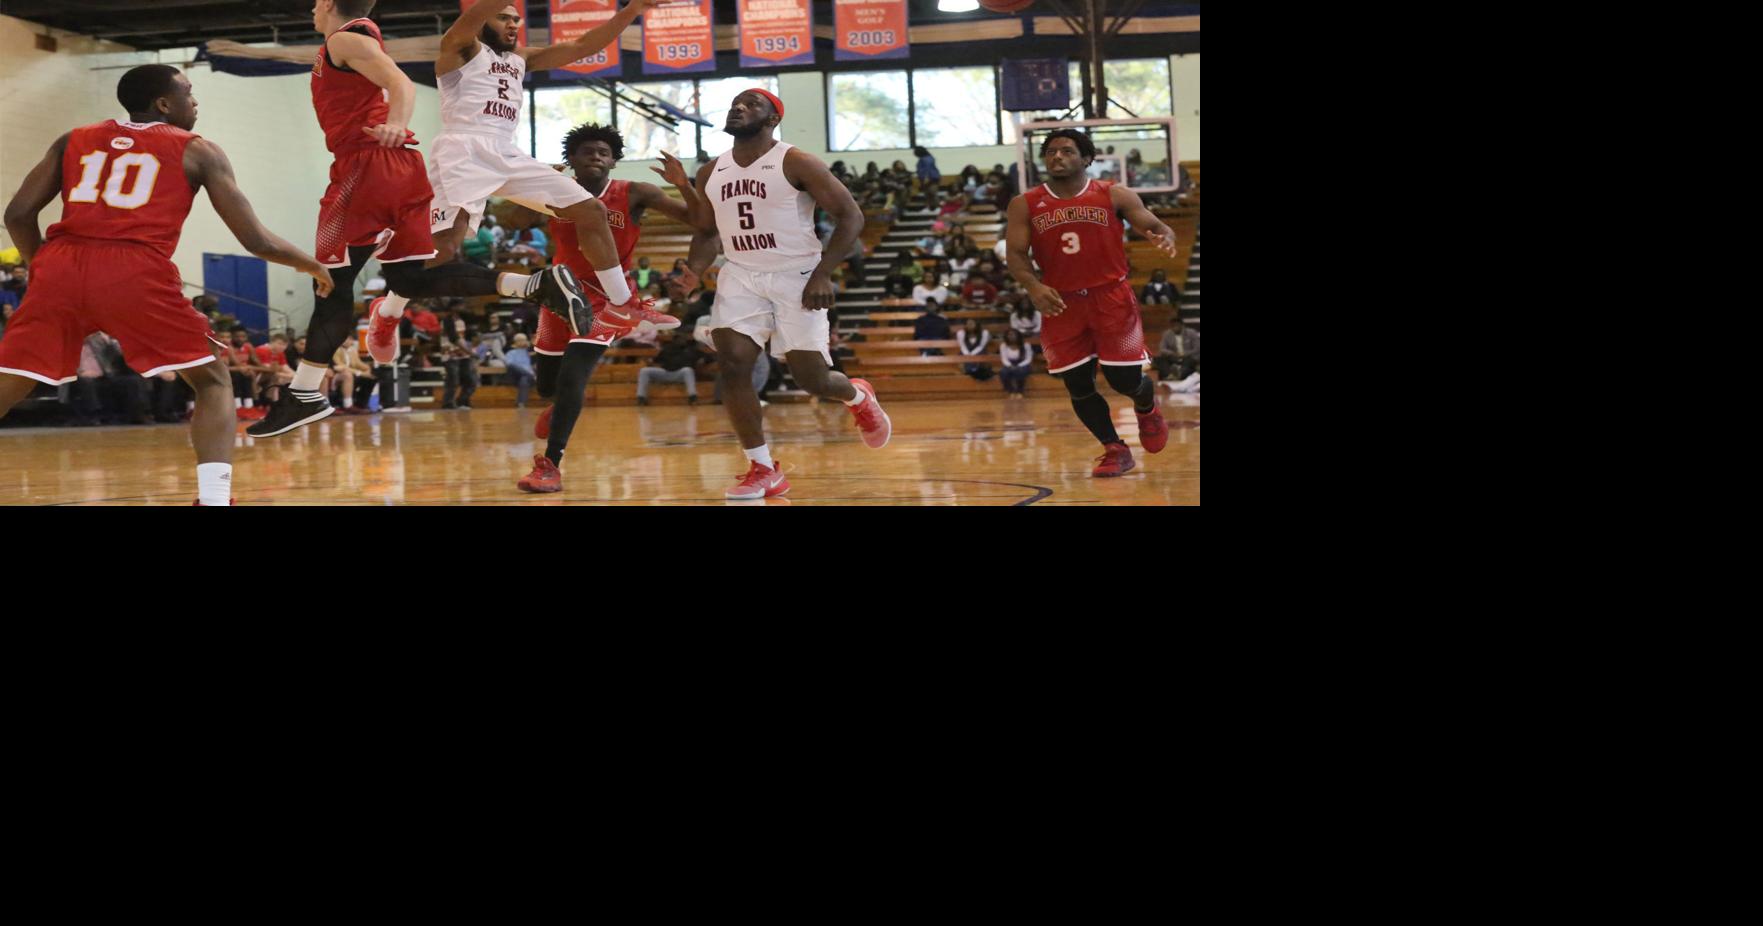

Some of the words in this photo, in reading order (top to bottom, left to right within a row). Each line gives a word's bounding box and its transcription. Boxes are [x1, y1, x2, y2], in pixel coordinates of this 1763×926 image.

[646, 15, 708, 29] CHAMPIONS
[743, 8, 806, 21] CHAMPIONS
[857, 16, 884, 24] GOLF
[754, 36, 800, 53] 1994
[848, 31, 896, 47] 2003
[656, 43, 701, 60] 1993
[497, 79, 510, 101] 2
[68, 150, 160, 209] 10
[721, 179, 767, 201] FRANCIS
[737, 202, 755, 230] 5
[1032, 206, 1109, 234] FLAGLER
[1060, 231, 1081, 255] 3
